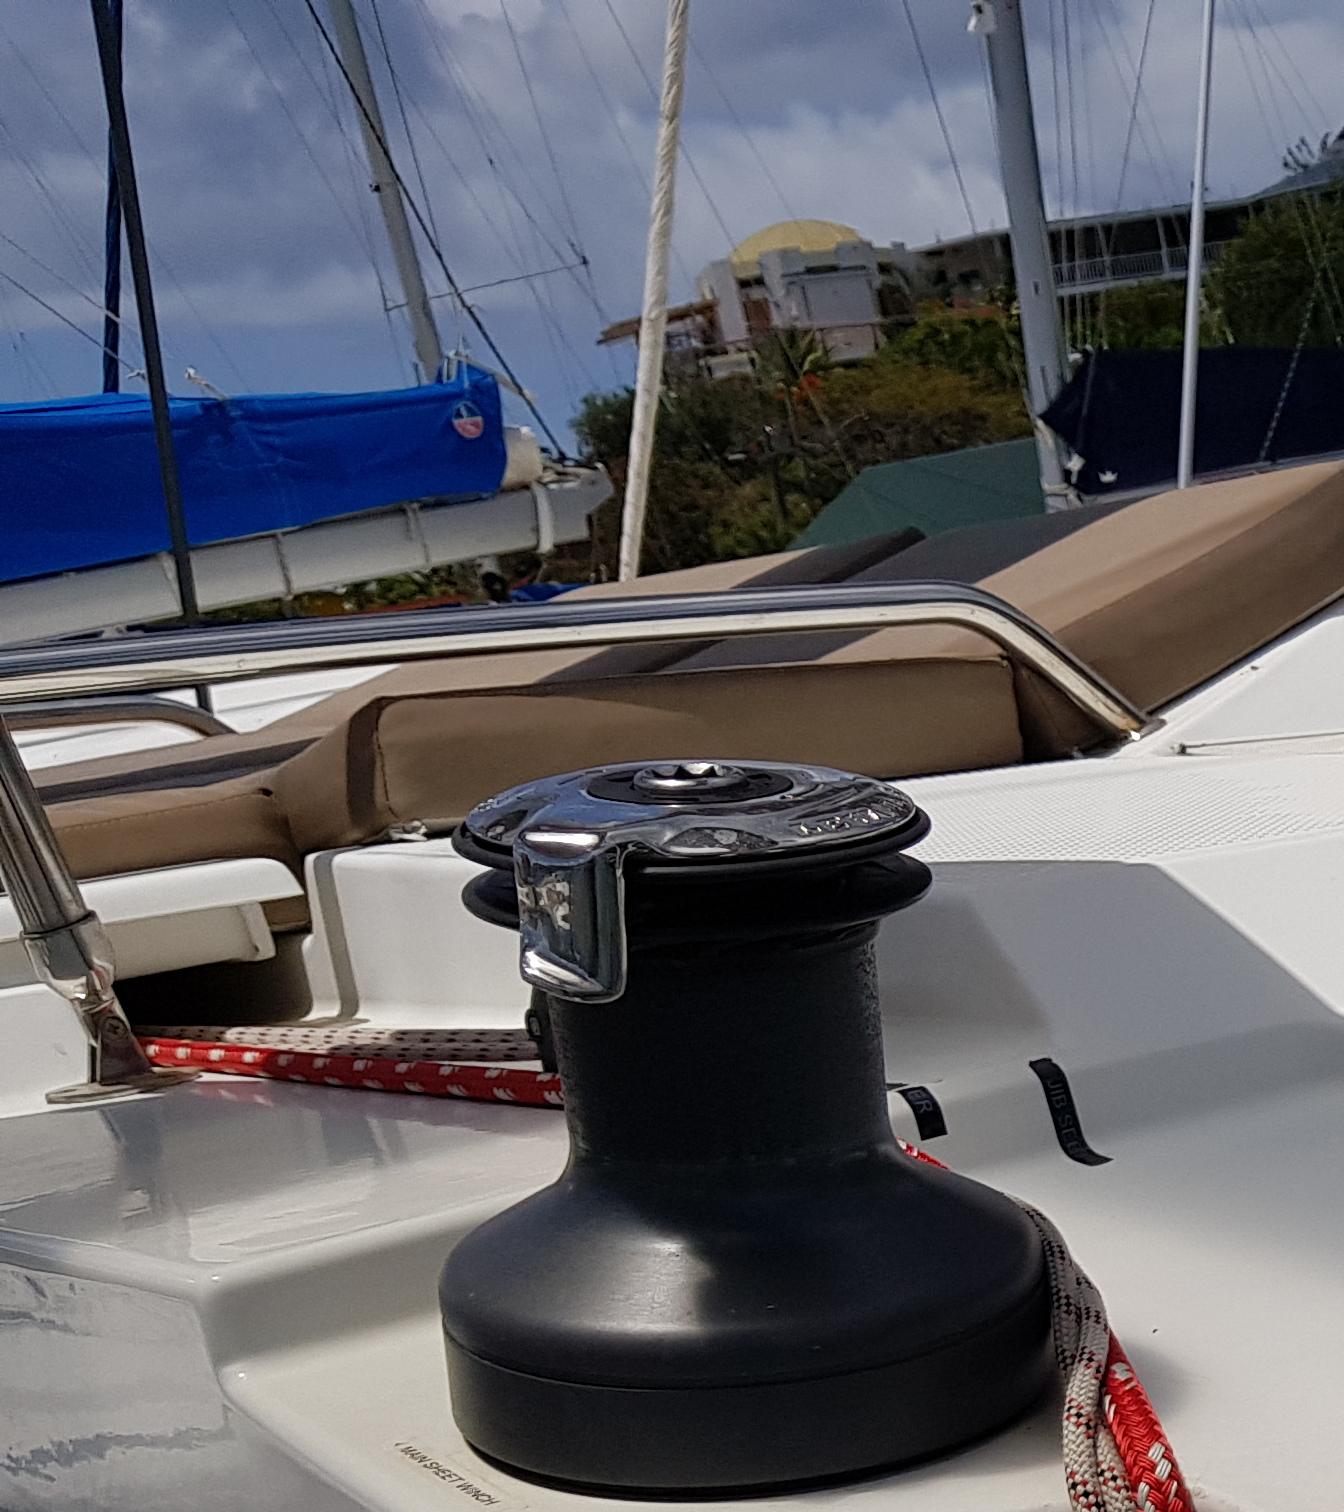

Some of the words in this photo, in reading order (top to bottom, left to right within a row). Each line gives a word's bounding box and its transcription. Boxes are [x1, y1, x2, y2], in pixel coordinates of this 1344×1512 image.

[1046, 1081, 1067, 1108] JIB
[422, 1461, 465, 1483] SHEET
[456, 1479, 501, 1506] WINCH
